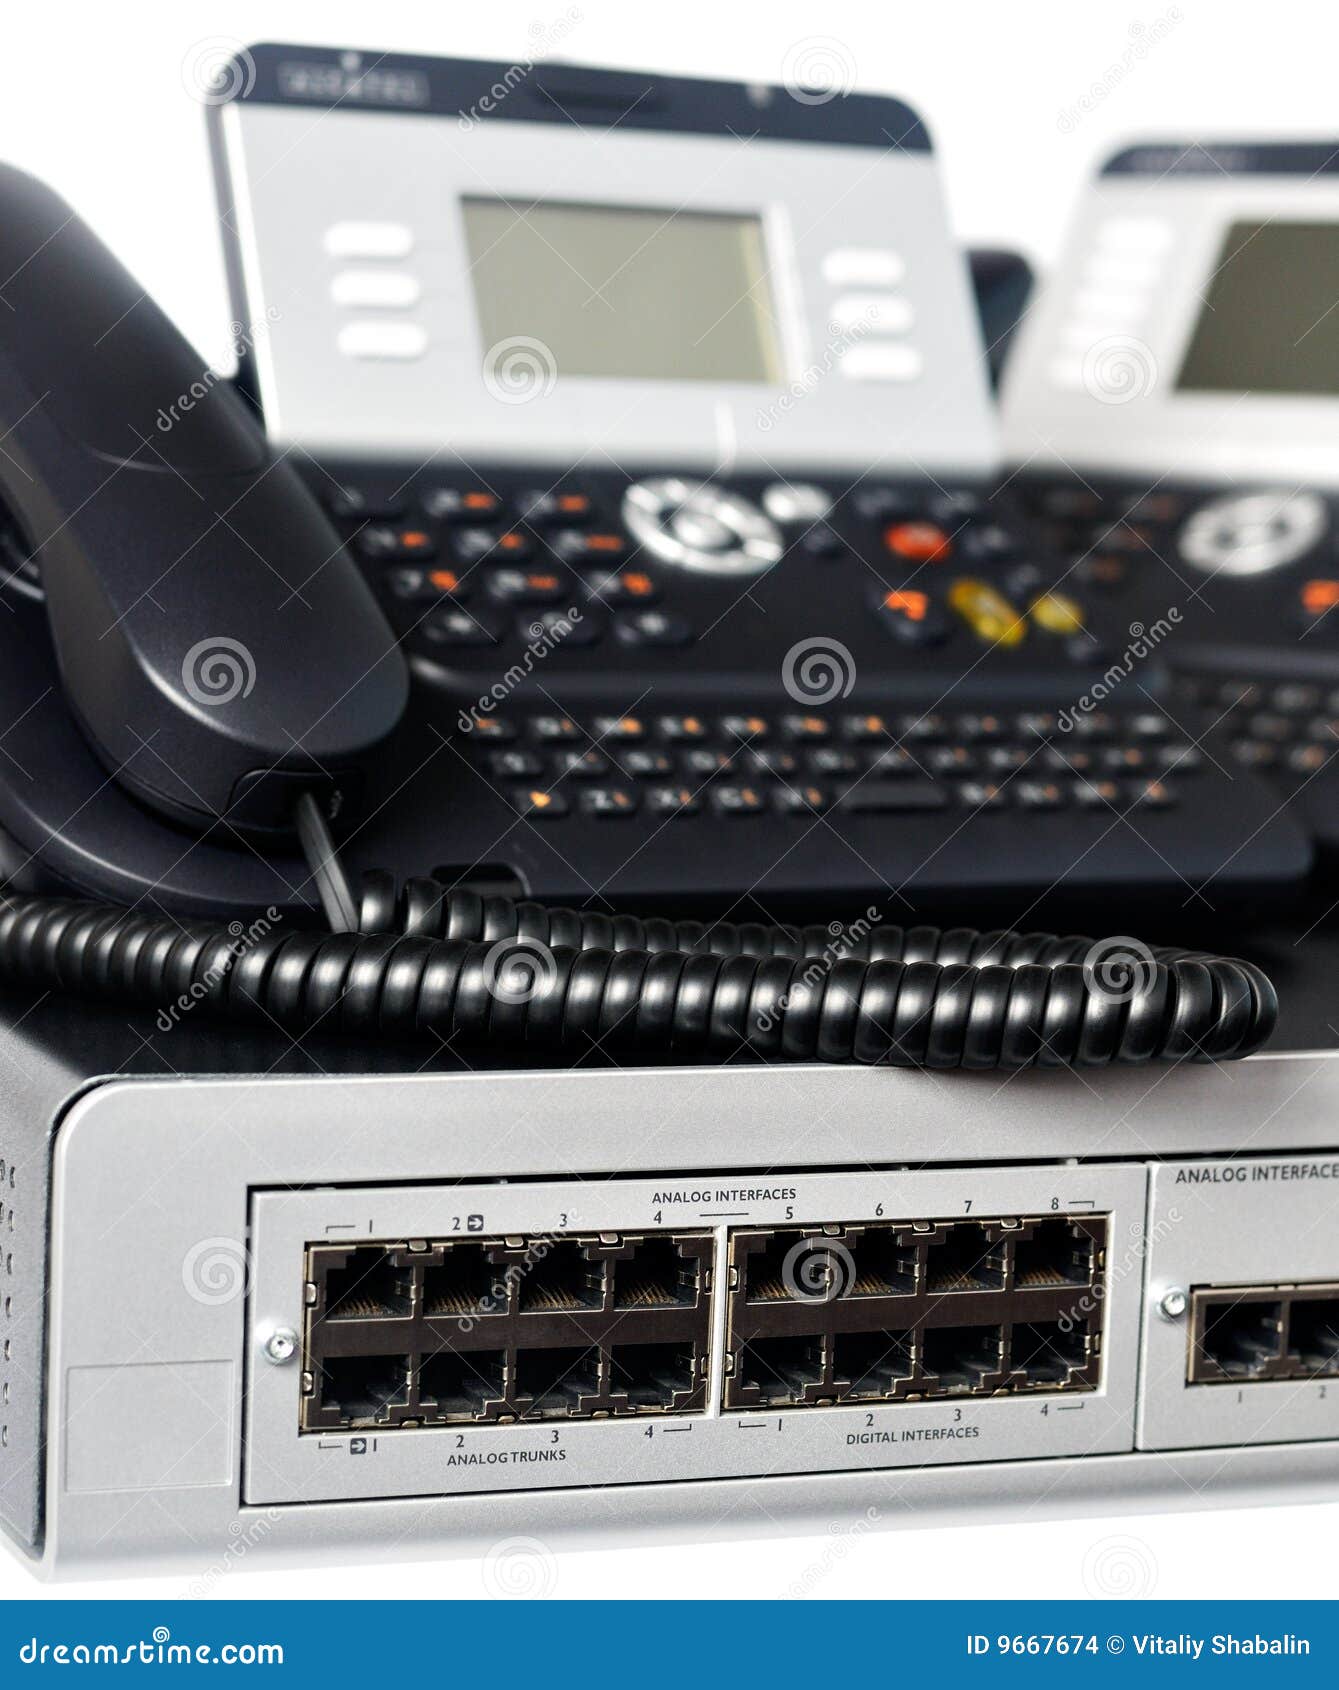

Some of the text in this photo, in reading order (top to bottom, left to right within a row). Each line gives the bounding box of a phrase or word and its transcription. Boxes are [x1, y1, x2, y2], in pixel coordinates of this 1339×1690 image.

[1174, 1166, 1248, 1183] ANALOG
[652, 1187, 797, 1204] ANALOG INTERFACES
[875, 1202, 884, 1217] 6
[964, 1199, 973, 1214] 7
[1050, 1196, 1059, 1211] 8
[559, 1213, 568, 1228] 3
[653, 1210, 662, 1225] 4
[785, 1206, 794, 1220] 5
[452, 1216, 461, 1231] 2
[953, 1408, 962, 1422] 3
[1040, 1403, 1049, 1417] 4
[865, 1413, 874, 1427] 2
[550, 1429, 560, 1444] 3
[644, 1424, 654, 1439] 4
[846, 1426, 979, 1445] DIGITAL INTERFACES
[455, 1434, 465, 1449] 2
[447, 1449, 566, 1466] ANALOG TRUNKS
